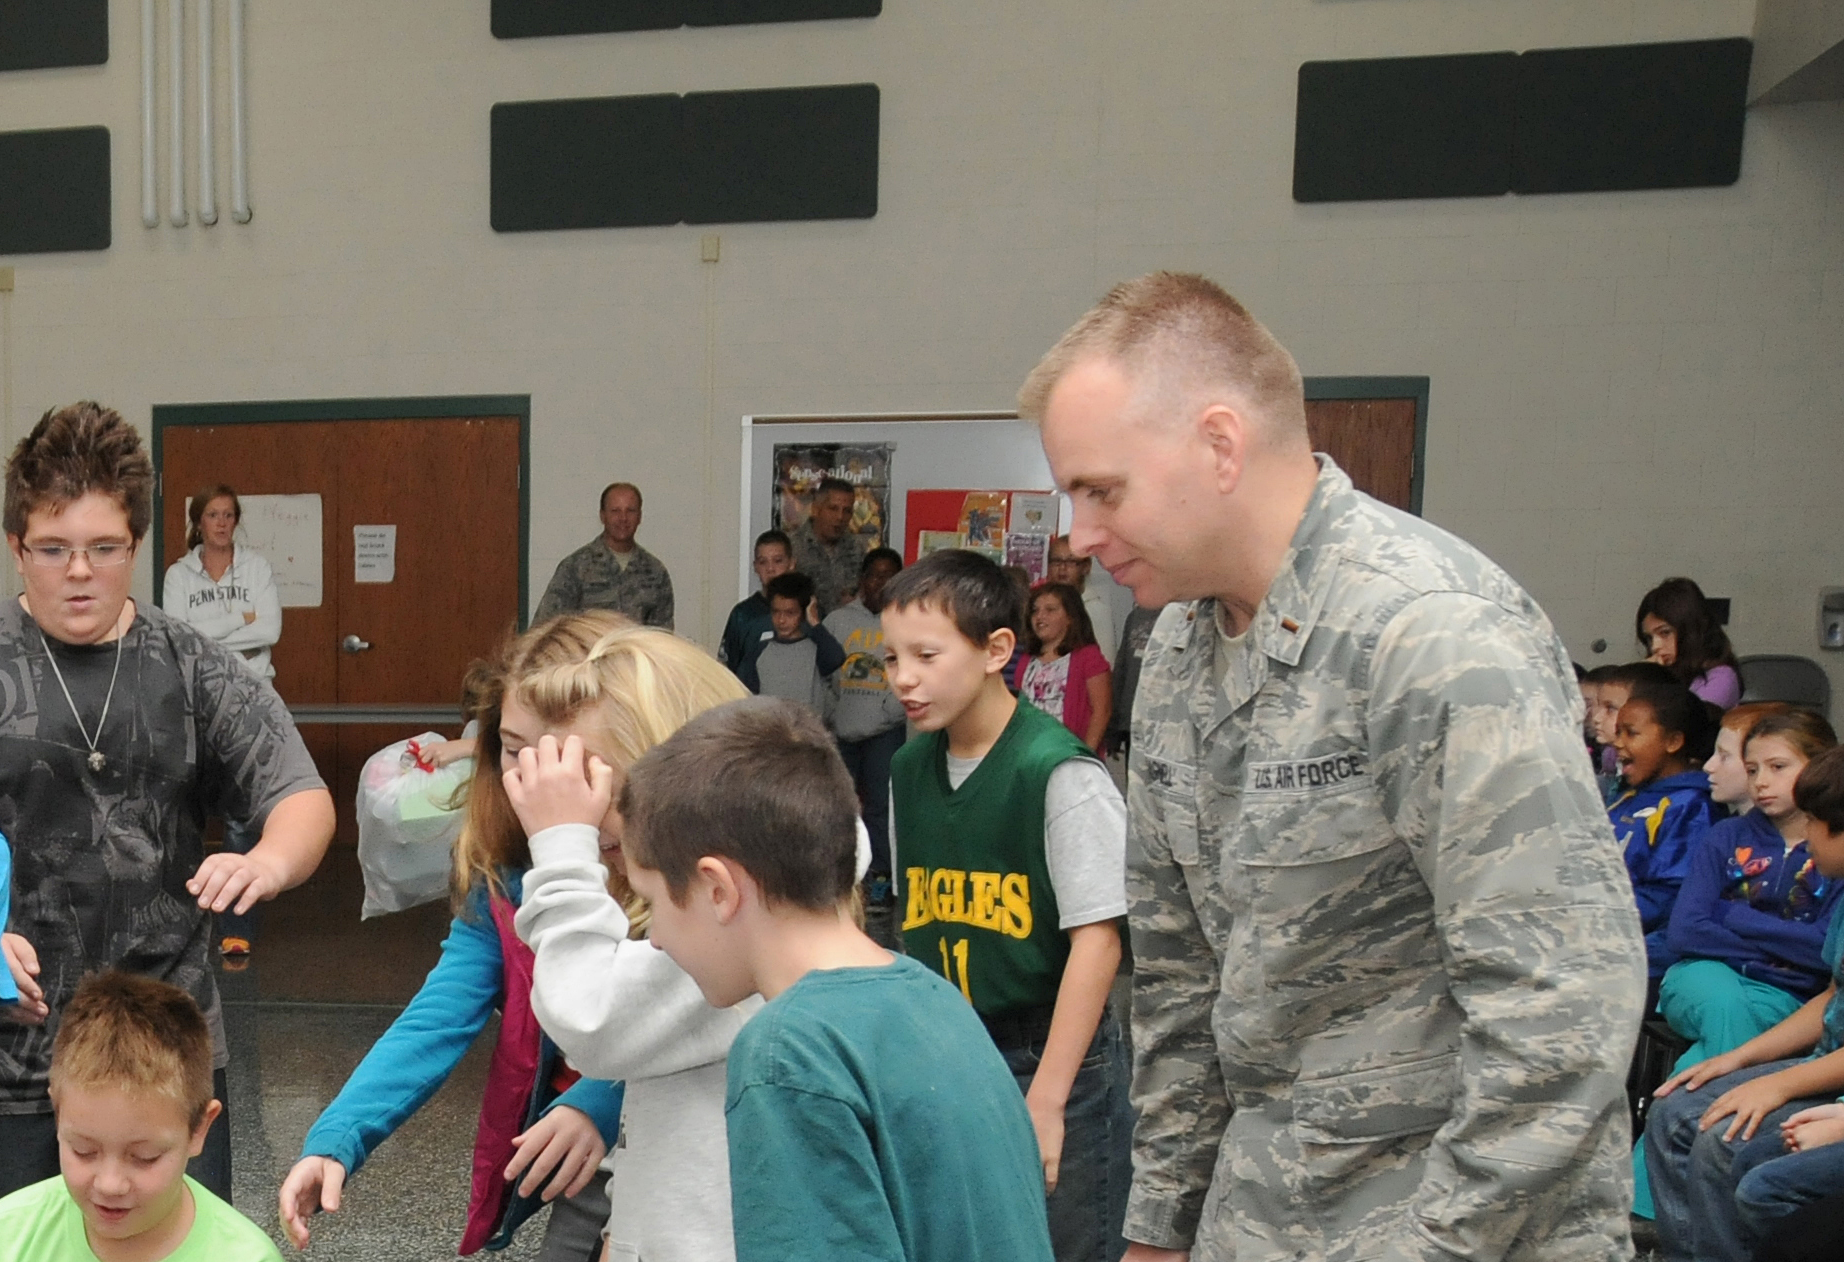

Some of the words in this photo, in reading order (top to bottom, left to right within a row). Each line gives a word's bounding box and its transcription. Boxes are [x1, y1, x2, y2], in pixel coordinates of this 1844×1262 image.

[189, 587, 215, 609] PENN
[216, 585, 250, 603] STATE
[1274, 766, 1295, 789] AIR
[1297, 755, 1365, 788] FORCE
[901, 866, 1033, 940] EGLES
